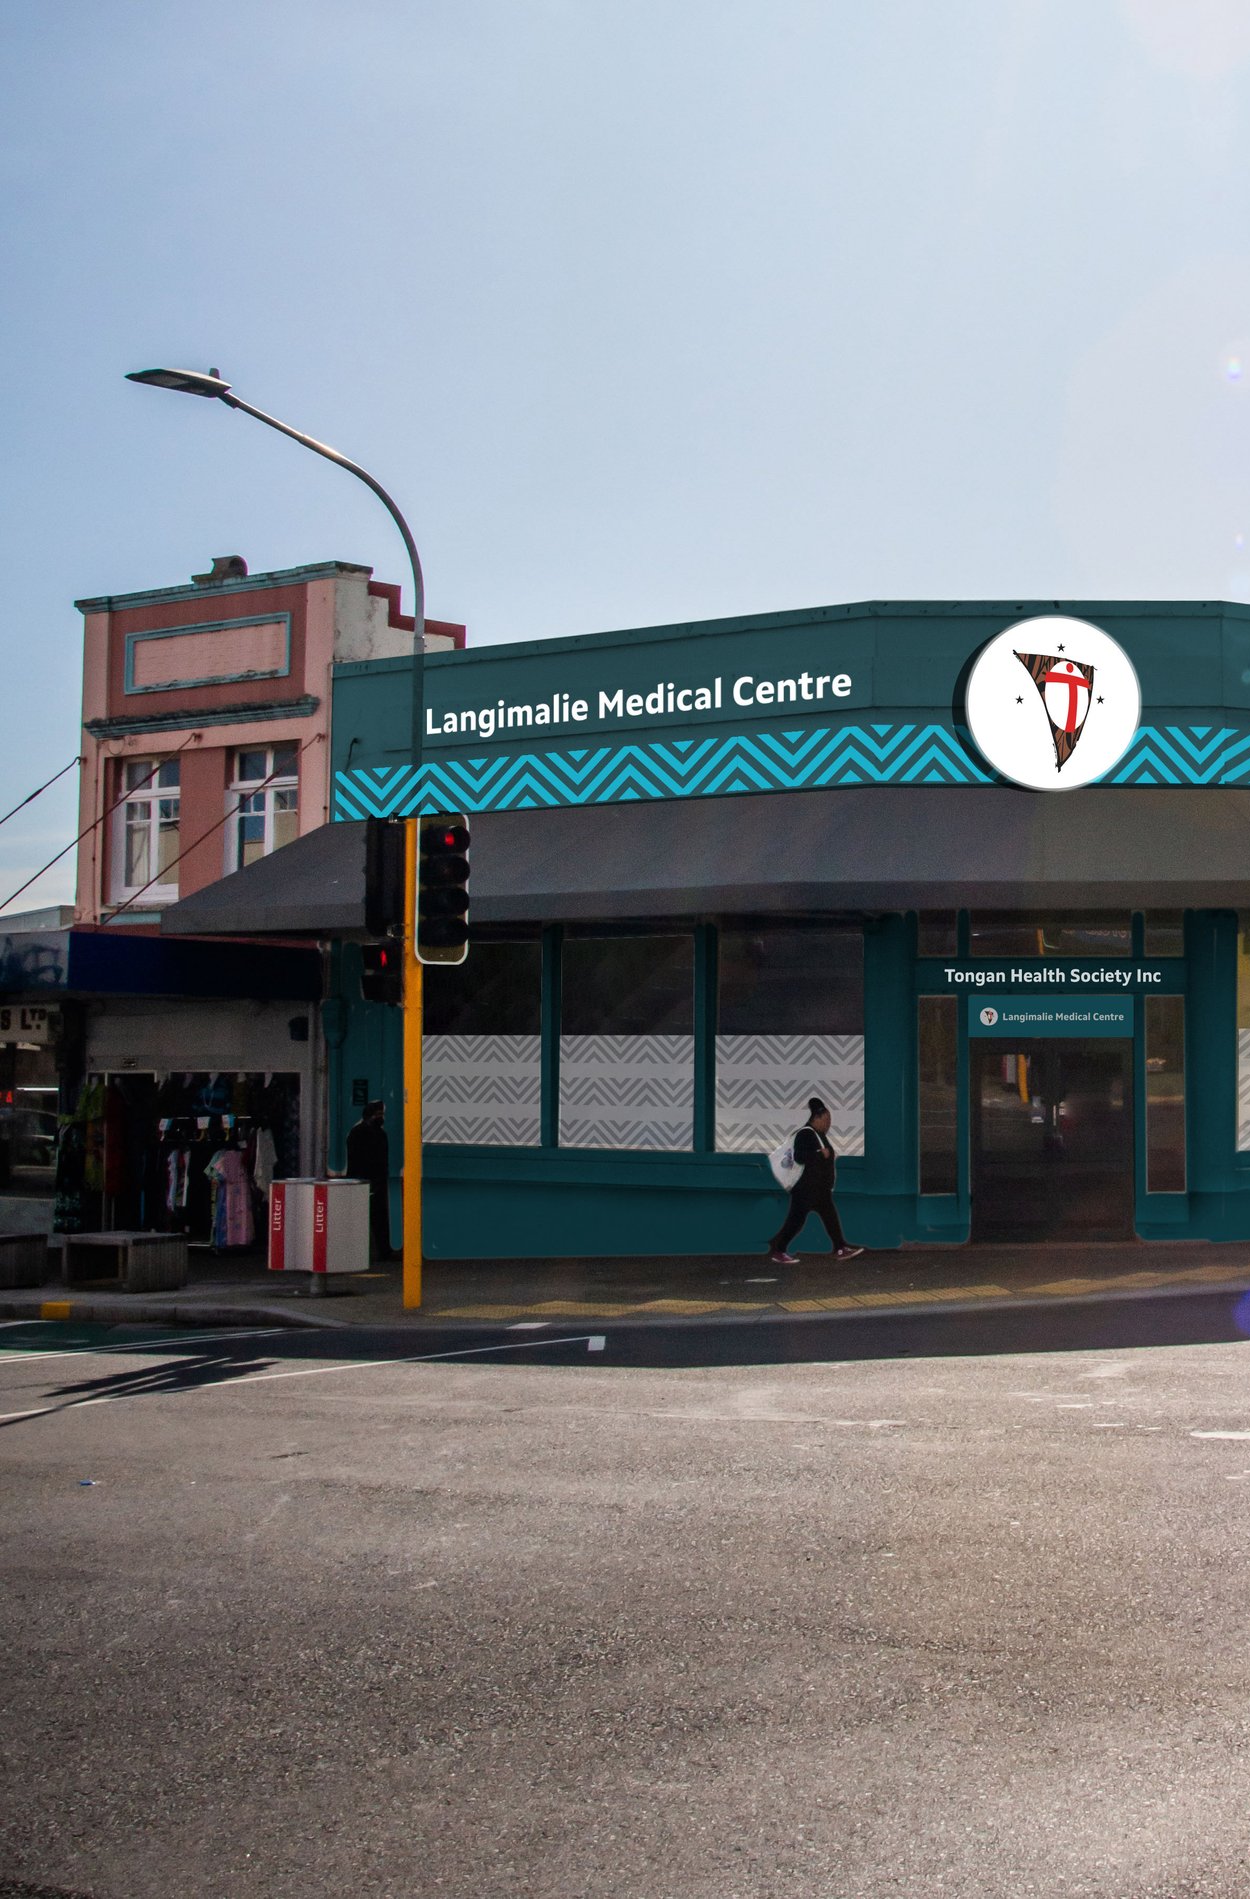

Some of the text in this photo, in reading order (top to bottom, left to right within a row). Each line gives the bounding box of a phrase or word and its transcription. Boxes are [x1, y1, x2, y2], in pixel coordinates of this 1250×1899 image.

[427, 672, 852, 738] Langimalie Medical Centre
[944, 968, 1161, 987] Tongan Health Society Inc
[1002, 1012, 1124, 1024] Langimalie Medical Centre
[272, 1198, 282, 1231] Litter
[315, 1199, 325, 1233] Litter
